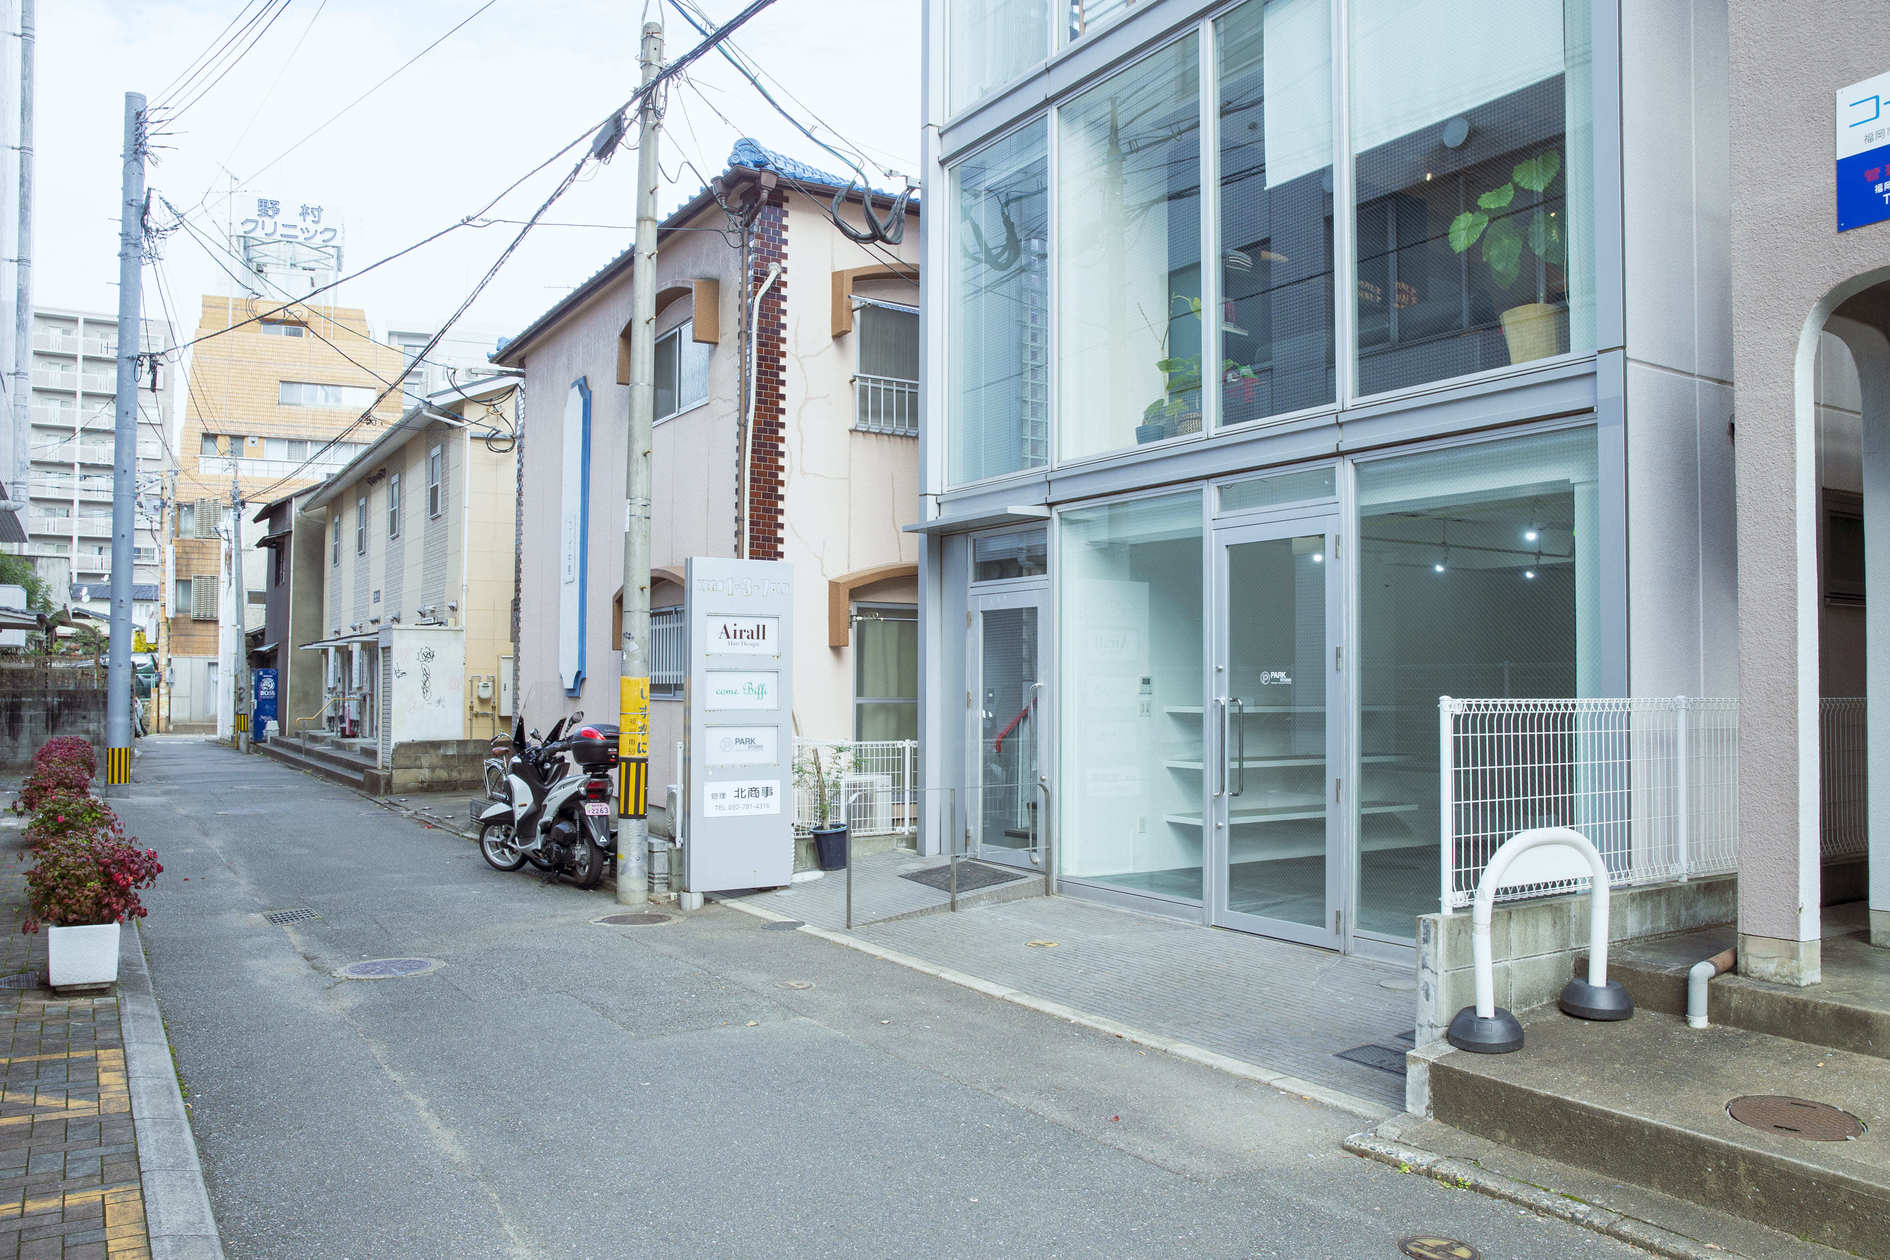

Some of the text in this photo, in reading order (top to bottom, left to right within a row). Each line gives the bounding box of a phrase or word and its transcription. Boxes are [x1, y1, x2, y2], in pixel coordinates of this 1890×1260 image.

[1848, 94, 1890, 128] コ
[256, 198, 323, 224] 野村
[240, 218, 337, 242] クリニック
[719, 623, 766, 640] Airall
[1270, 671, 1286, 679] PARK
[734, 737, 756, 745] PARK
[733, 786, 774, 799] 北商事
